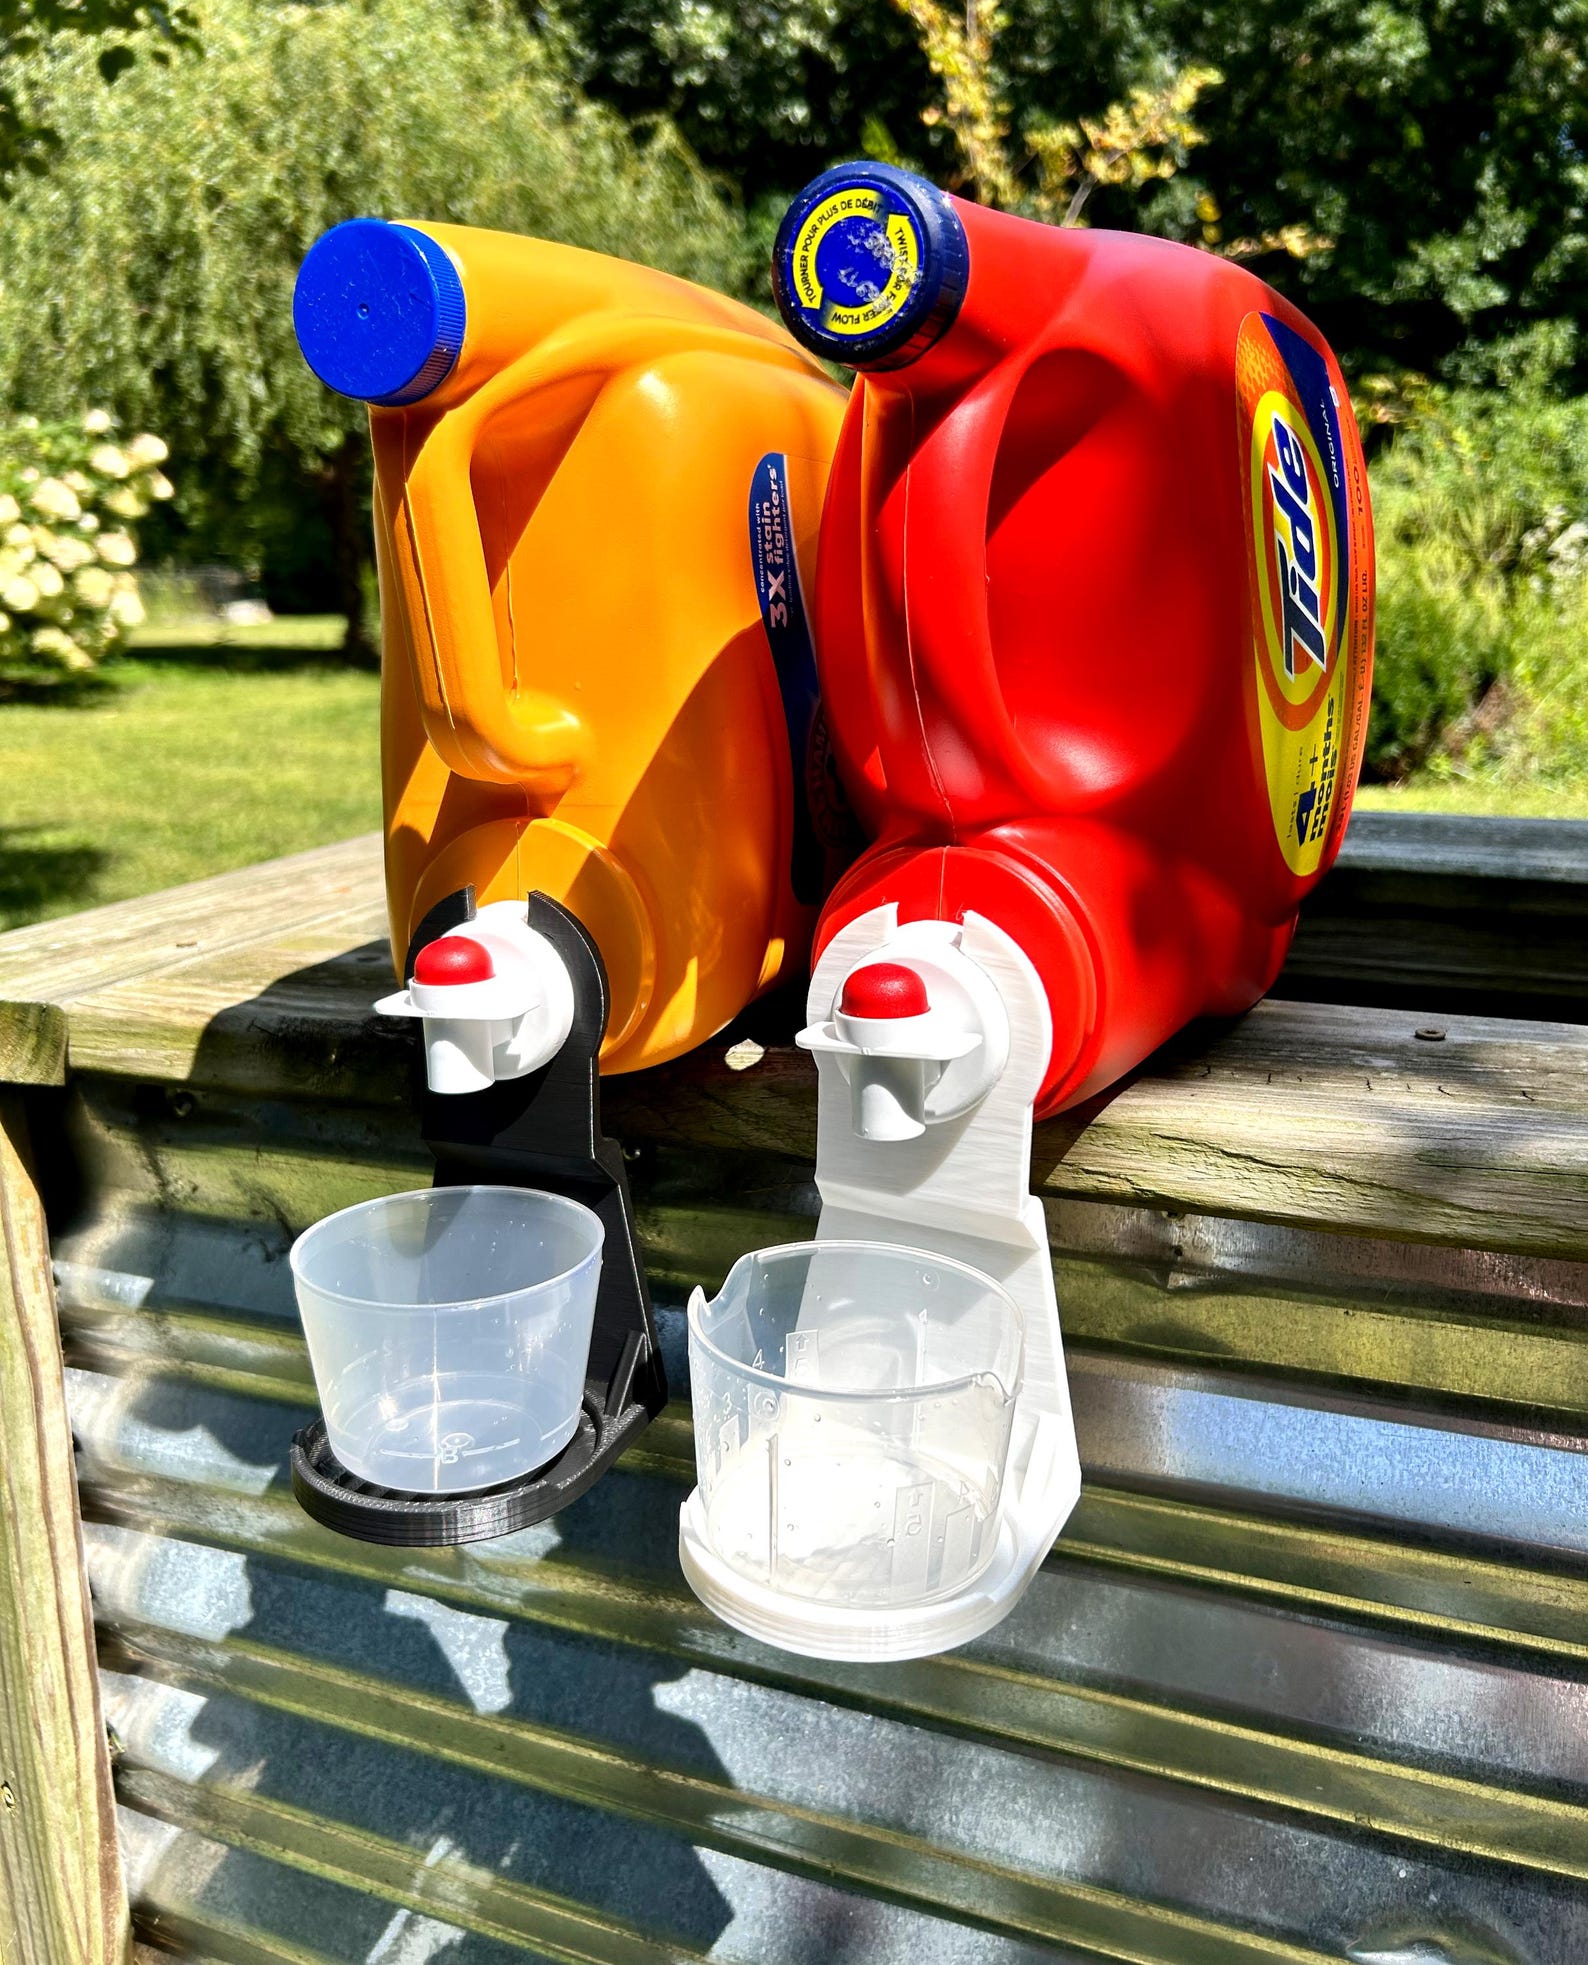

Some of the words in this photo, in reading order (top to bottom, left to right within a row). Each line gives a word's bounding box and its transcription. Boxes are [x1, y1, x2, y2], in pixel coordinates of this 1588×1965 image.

[818, 204, 840, 226] PLUS
[840, 199, 853, 211] DE
[855, 196, 883, 214] DÉBIT
[801, 224, 820, 254] POUR
[894, 226, 909, 263] TWIST
[800, 254, 816, 304] TOURNER
[831, 311, 861, 325] FLOW
[863, 291, 897, 321] FTER
[1319, 397, 1340, 489] ORIGINAL
[1353, 466, 1363, 516] 100
[761, 501, 774, 565] stain
[1267, 409, 1328, 681] Tide
[756, 526, 766, 593] concentrated
[767, 569, 788, 628] 3X
[1361, 596, 1368, 612] OZ
[1286, 800, 1297, 838] lasts
[1294, 746, 1304, 785] dure
[752, 1348, 765, 1370] 4
